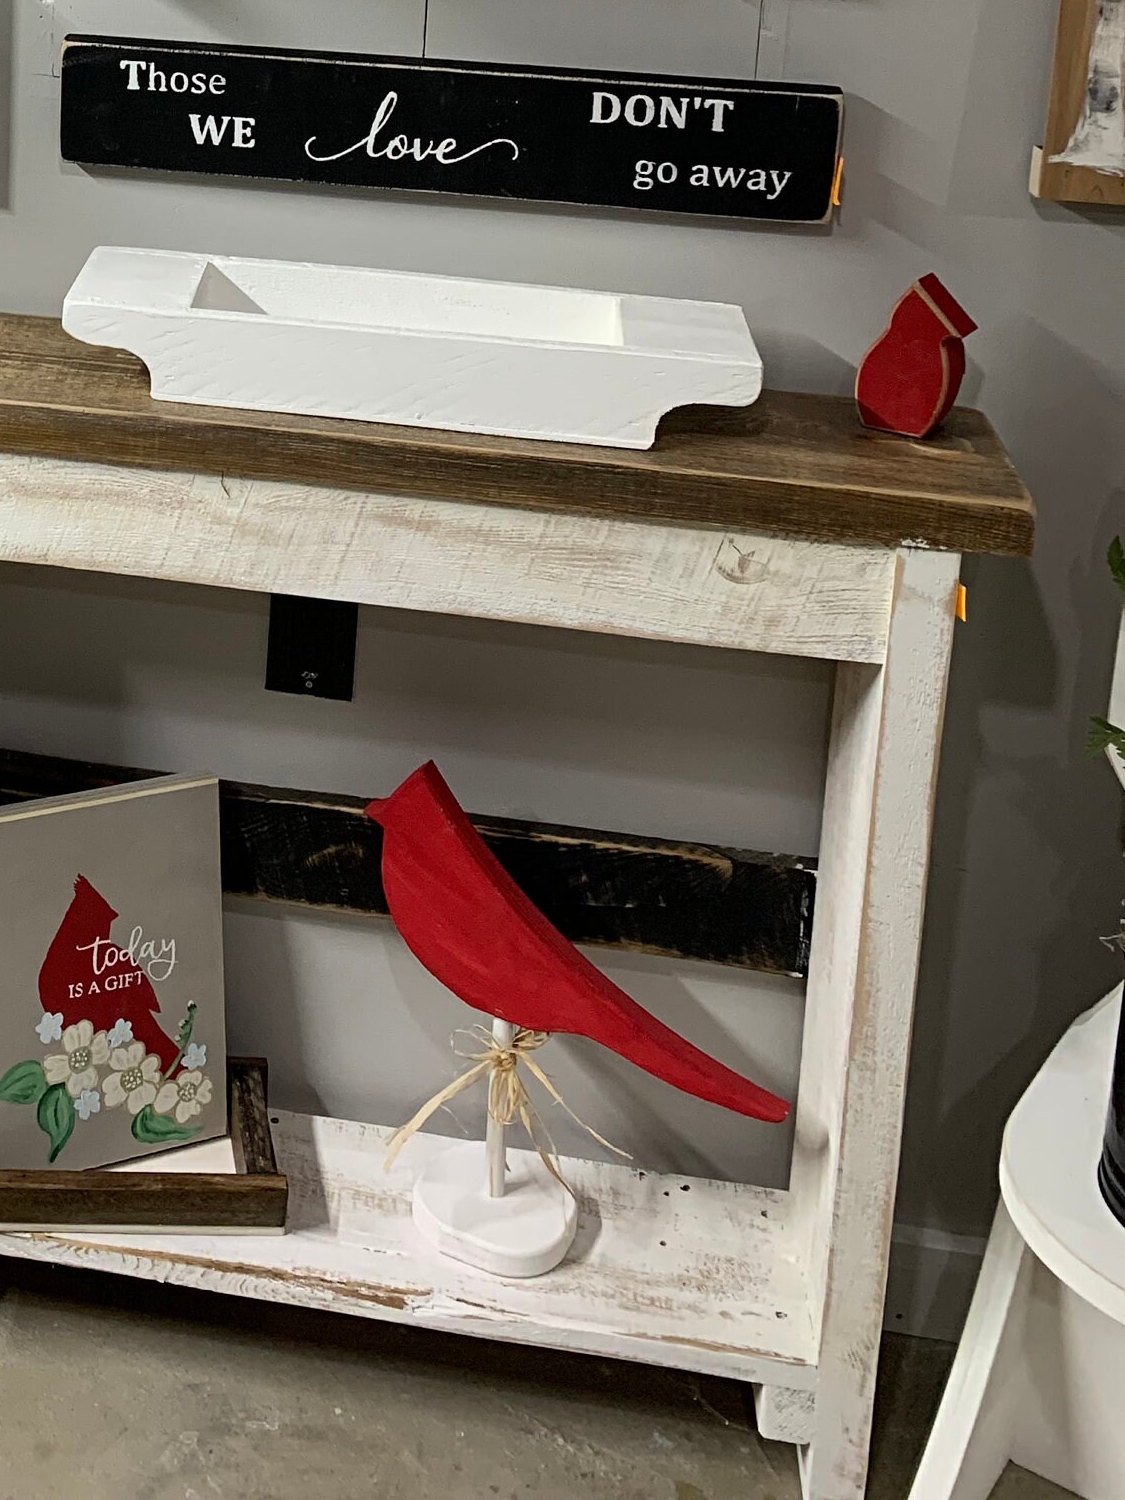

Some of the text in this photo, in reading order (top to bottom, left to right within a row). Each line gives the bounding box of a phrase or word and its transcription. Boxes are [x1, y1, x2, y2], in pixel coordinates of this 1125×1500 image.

[119, 59, 227, 95] Those
[589, 91, 735, 132] DON'T
[189, 114, 256, 149] WE
[633, 160, 793, 200] go away
[76, 925, 179, 981] today
[68, 970, 145, 999] IS A GIFT
